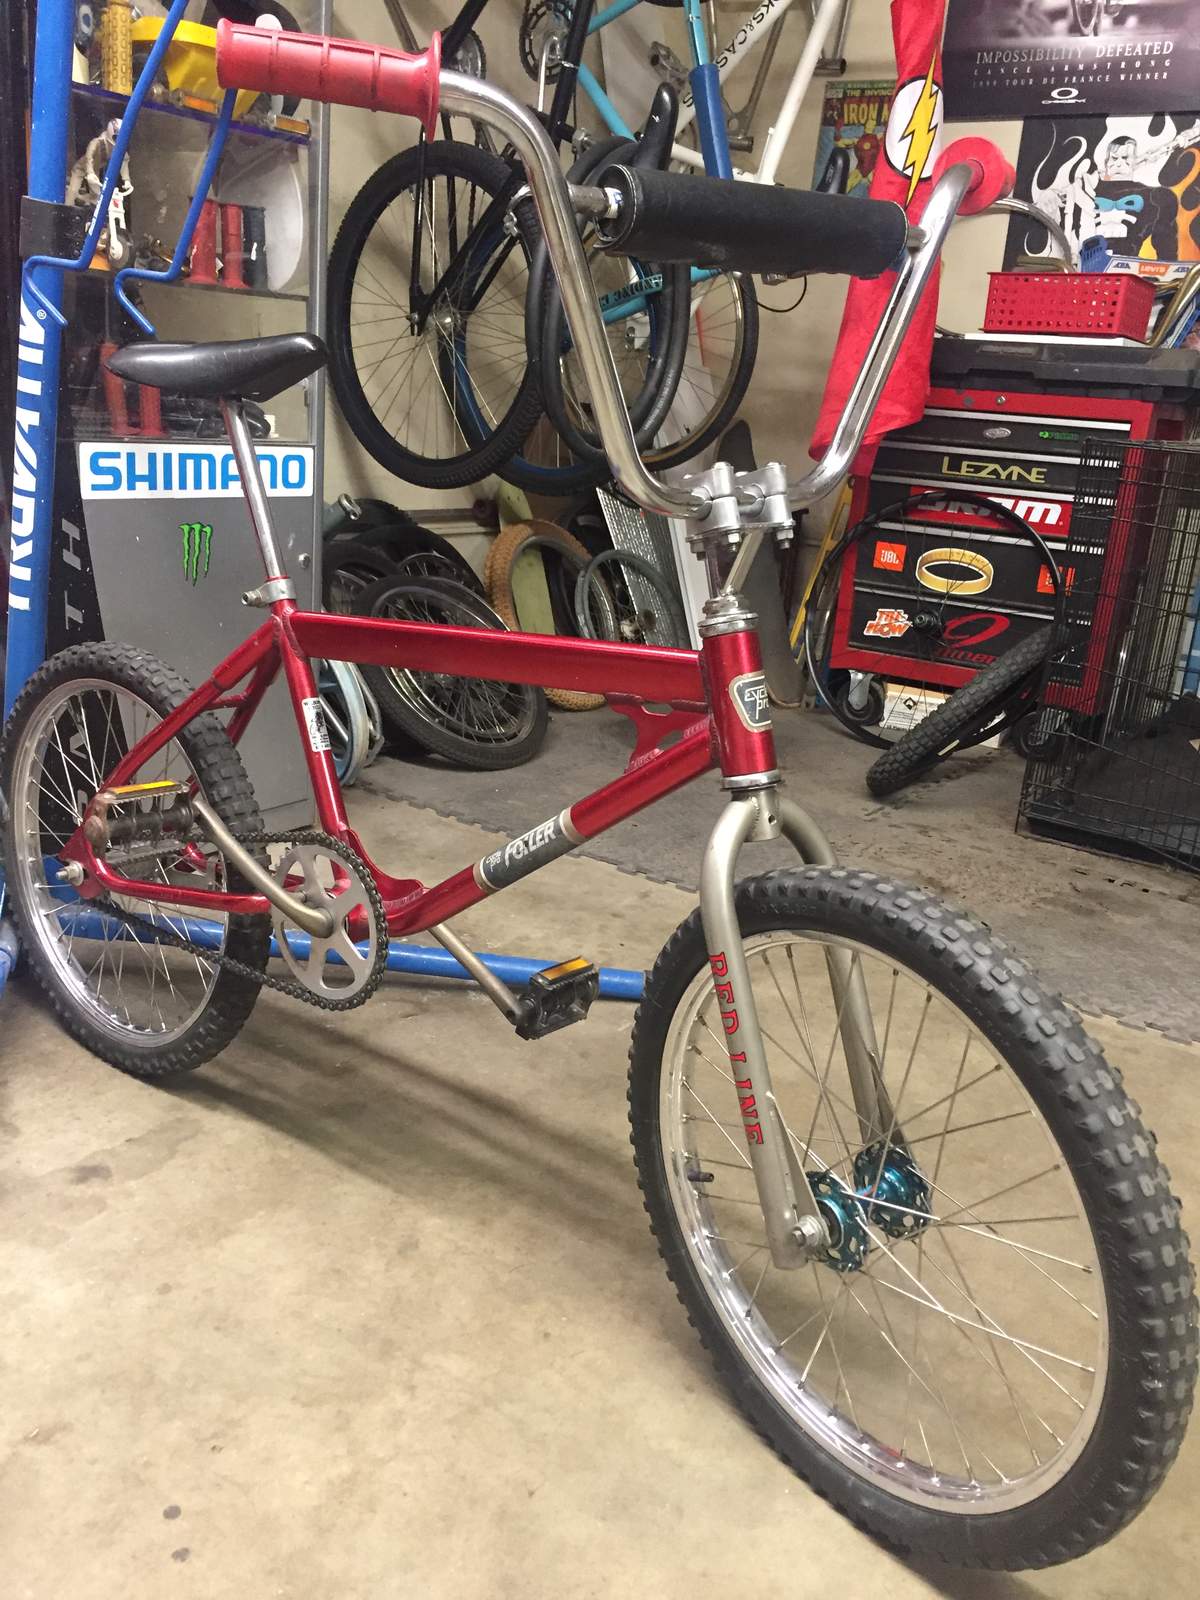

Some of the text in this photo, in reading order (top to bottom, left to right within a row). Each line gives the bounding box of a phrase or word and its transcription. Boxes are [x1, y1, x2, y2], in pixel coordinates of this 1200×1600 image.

[976, 40, 1174, 65] IMPOSSIBILITY DEFEATED
[974, 59, 1171, 76] LANCE ARMSTRONG
[1006, 78, 1034, 86] TOUR
[1064, 74, 1111, 83] FRANCE
[1120, 71, 1169, 81] WINNER
[843, 103, 878, 124] IRON
[942, 456, 1048, 483] LEZYNE
[709, 952, 740, 1035] RED
